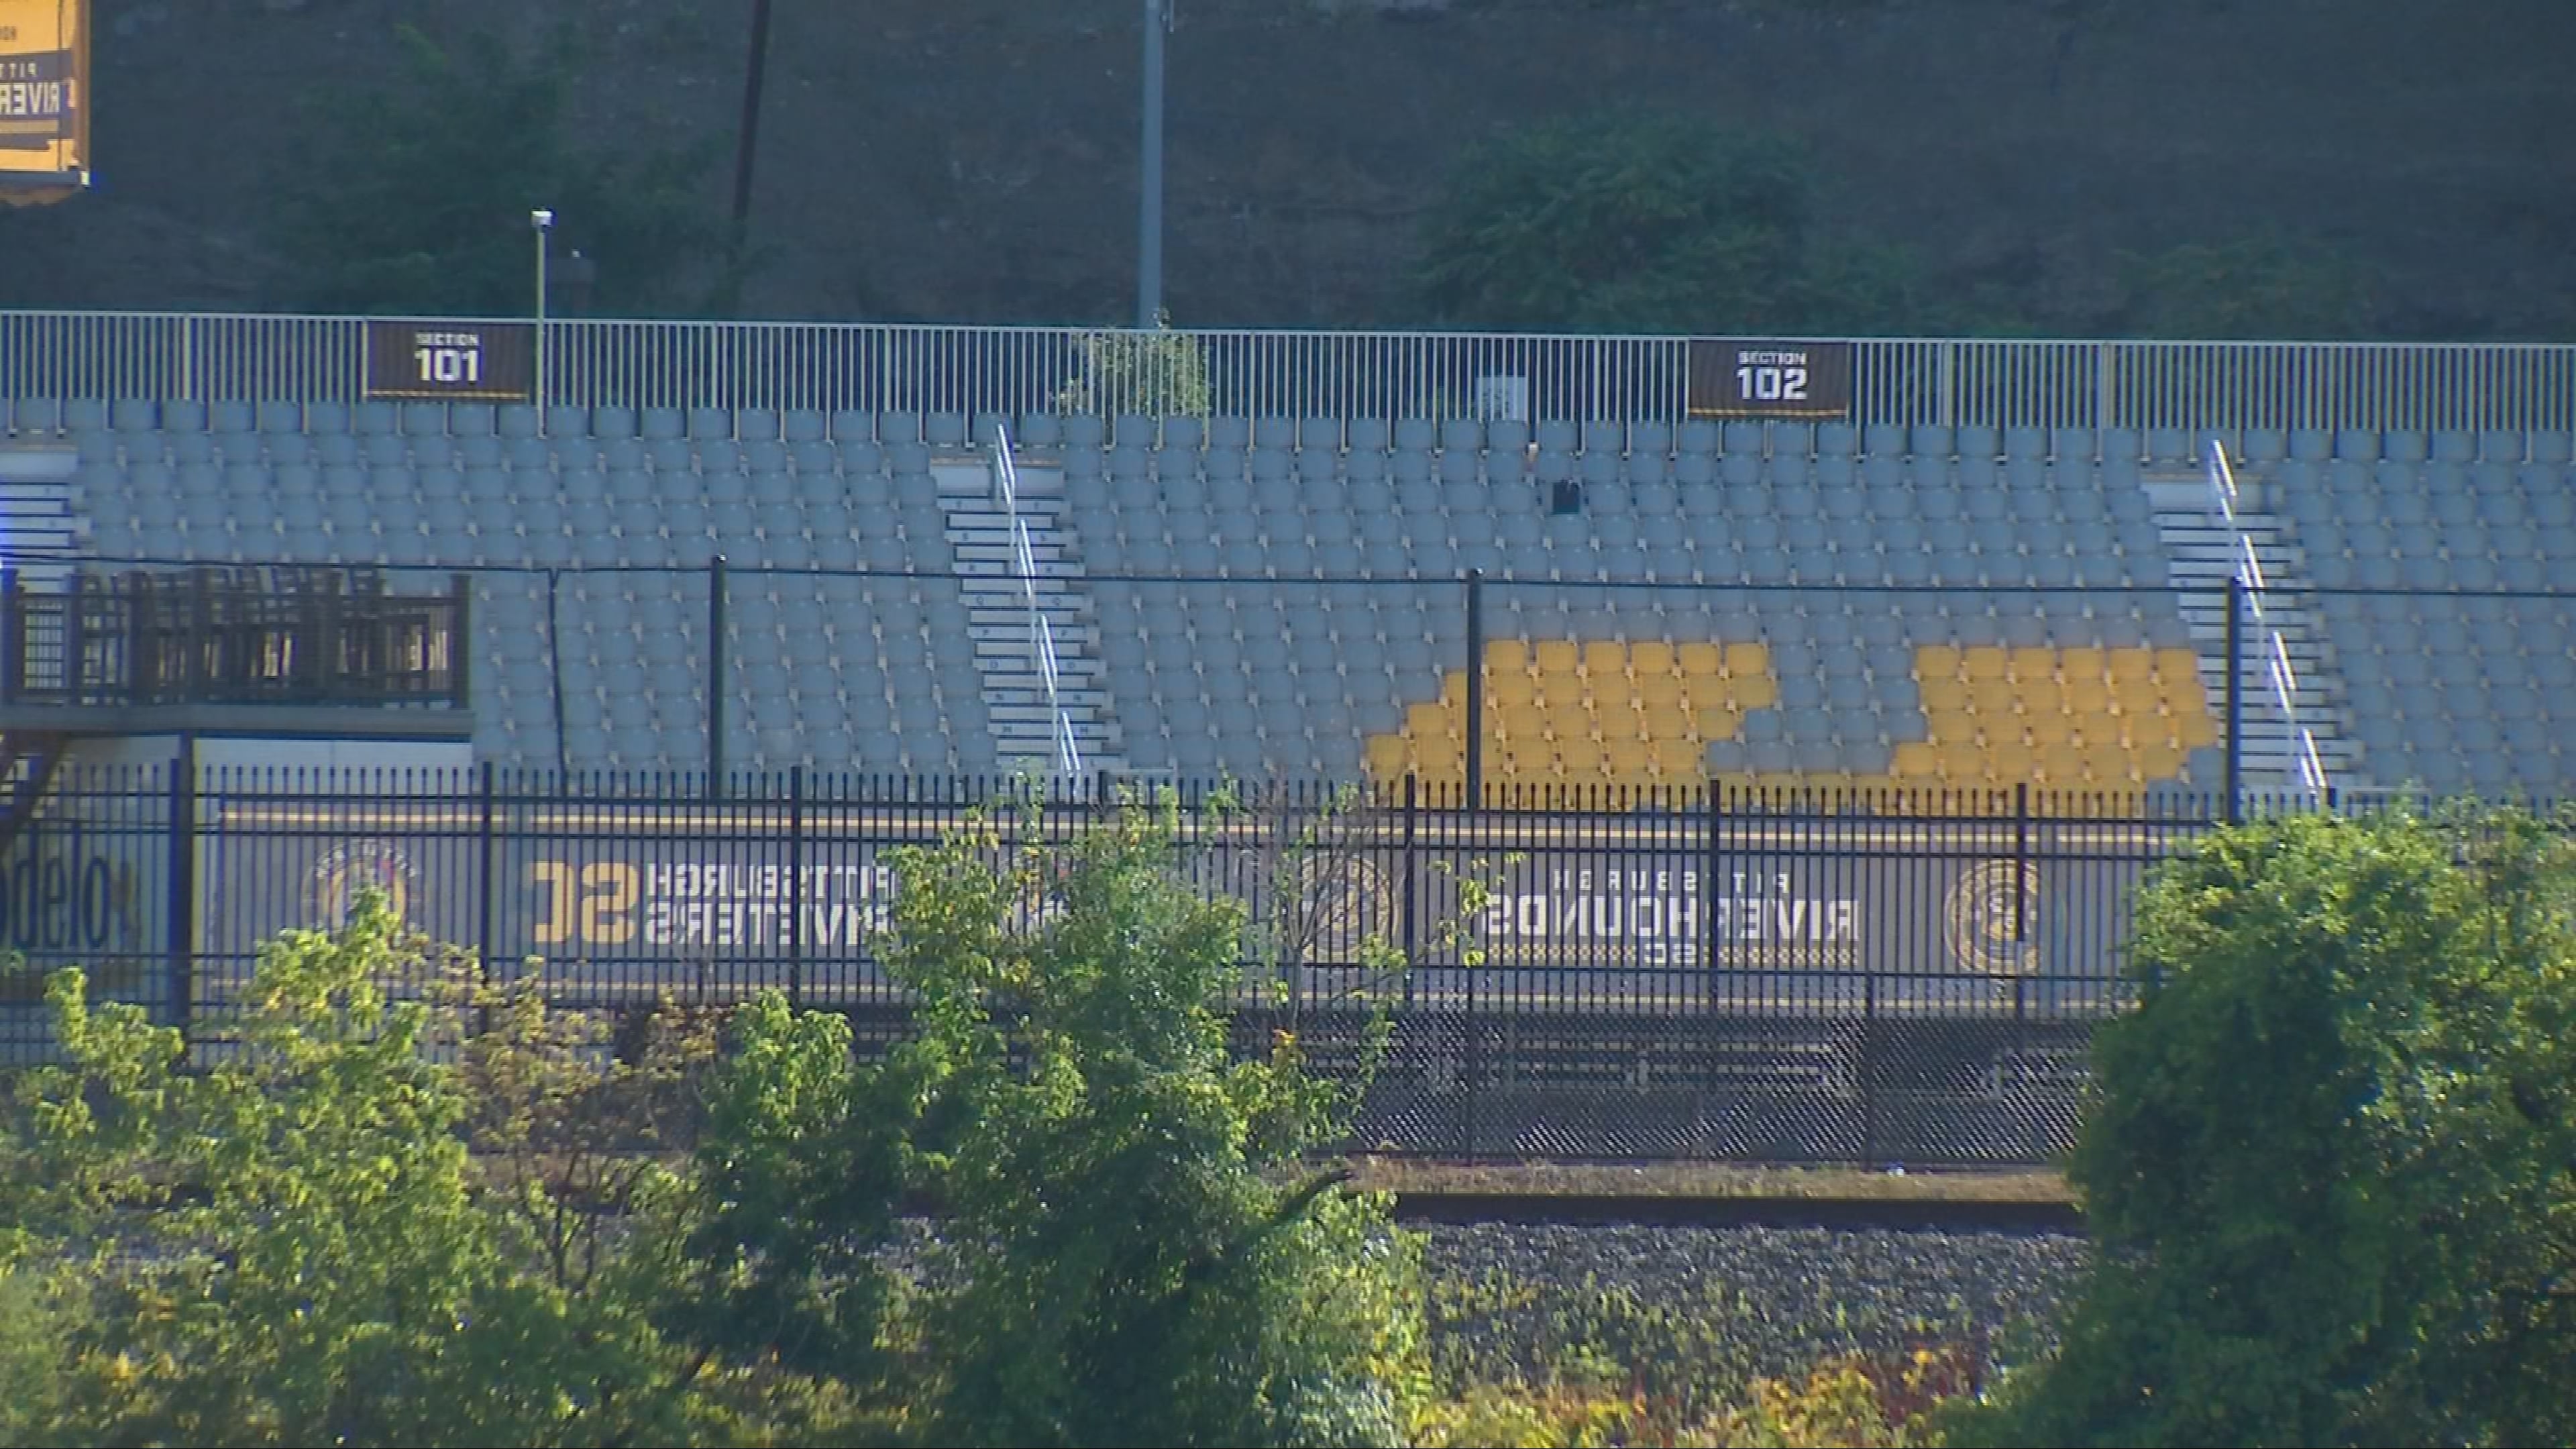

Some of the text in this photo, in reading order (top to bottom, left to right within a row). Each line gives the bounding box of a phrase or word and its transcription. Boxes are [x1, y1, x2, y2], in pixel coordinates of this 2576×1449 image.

[415, 333, 478, 345] SECTION
[414, 348, 478, 381] 101
[1737, 351, 1807, 364] SECTION
[1736, 367, 1808, 399] 102
[0, 822, 111, 949] delo
